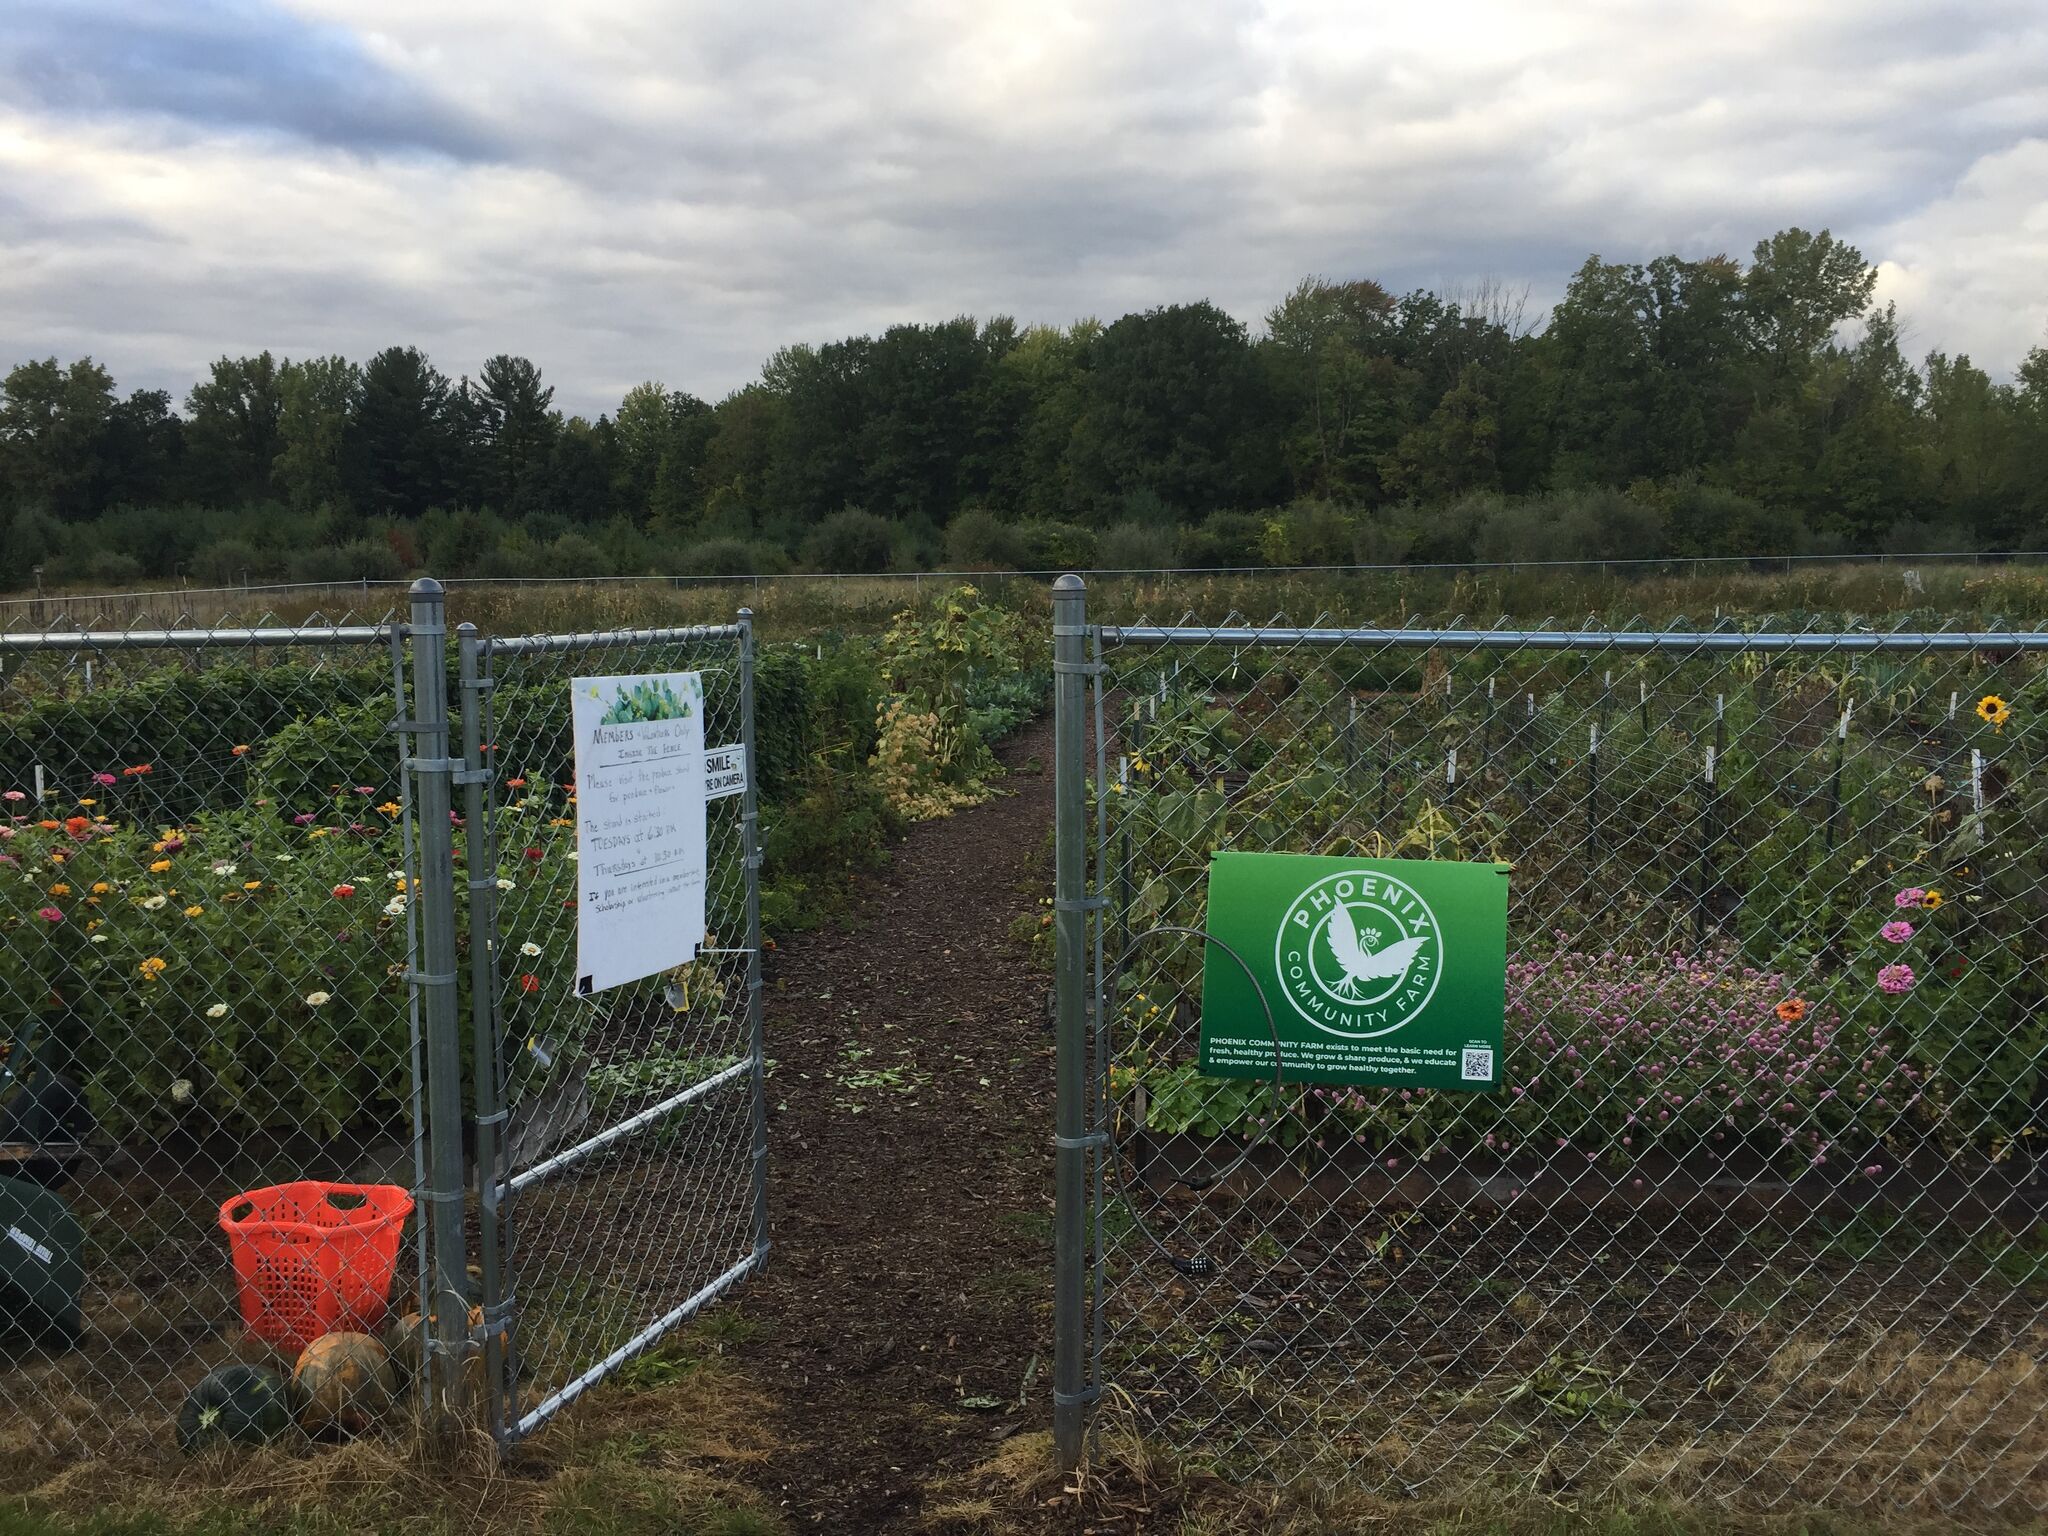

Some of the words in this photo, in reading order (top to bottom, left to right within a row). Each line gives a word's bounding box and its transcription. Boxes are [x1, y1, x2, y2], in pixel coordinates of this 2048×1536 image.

[706, 755, 731, 774] SMILE
[714, 777, 722, 789] ON
[722, 772, 744, 787] CAMERA
[1293, 878, 1431, 934] PHOENIX
[1287, 951, 1389, 1027] COMMUNITY
[1395, 955, 1432, 1012] FARM
[1209, 1037, 1247, 1046] PHOENIX
[1249, 1039, 1299, 1049] COMMNITY
[1301, 1041, 1324, 1050] FARM
[1326, 1043, 1349, 1051] exists
[1362, 1045, 1382, 1053] meet
[1384, 1045, 1399, 1054] the
[1400, 1046, 1421, 1055] basic
[1423, 1047, 1443, 1056] need
[1445, 1047, 1457, 1056] for
[1208, 1056, 1215, 1064] &
[1216, 1057, 1253, 1067] empower
[1255, 1059, 1269, 1067] our
[1349, 1063, 1379, 1073] healthy
[1380, 1065, 1417, 1074] together.
[1209, 1047, 1232, 1056] fresh,
[1233, 1048, 1263, 1058] healthy
[1315, 1053, 1336, 1061] grow
[1337, 1053, 1343, 1061] &
[1345, 1054, 1366, 1062] share
[1368, 1055, 1403, 1065] produce,
[1424, 1057, 1457, 1067] educate
